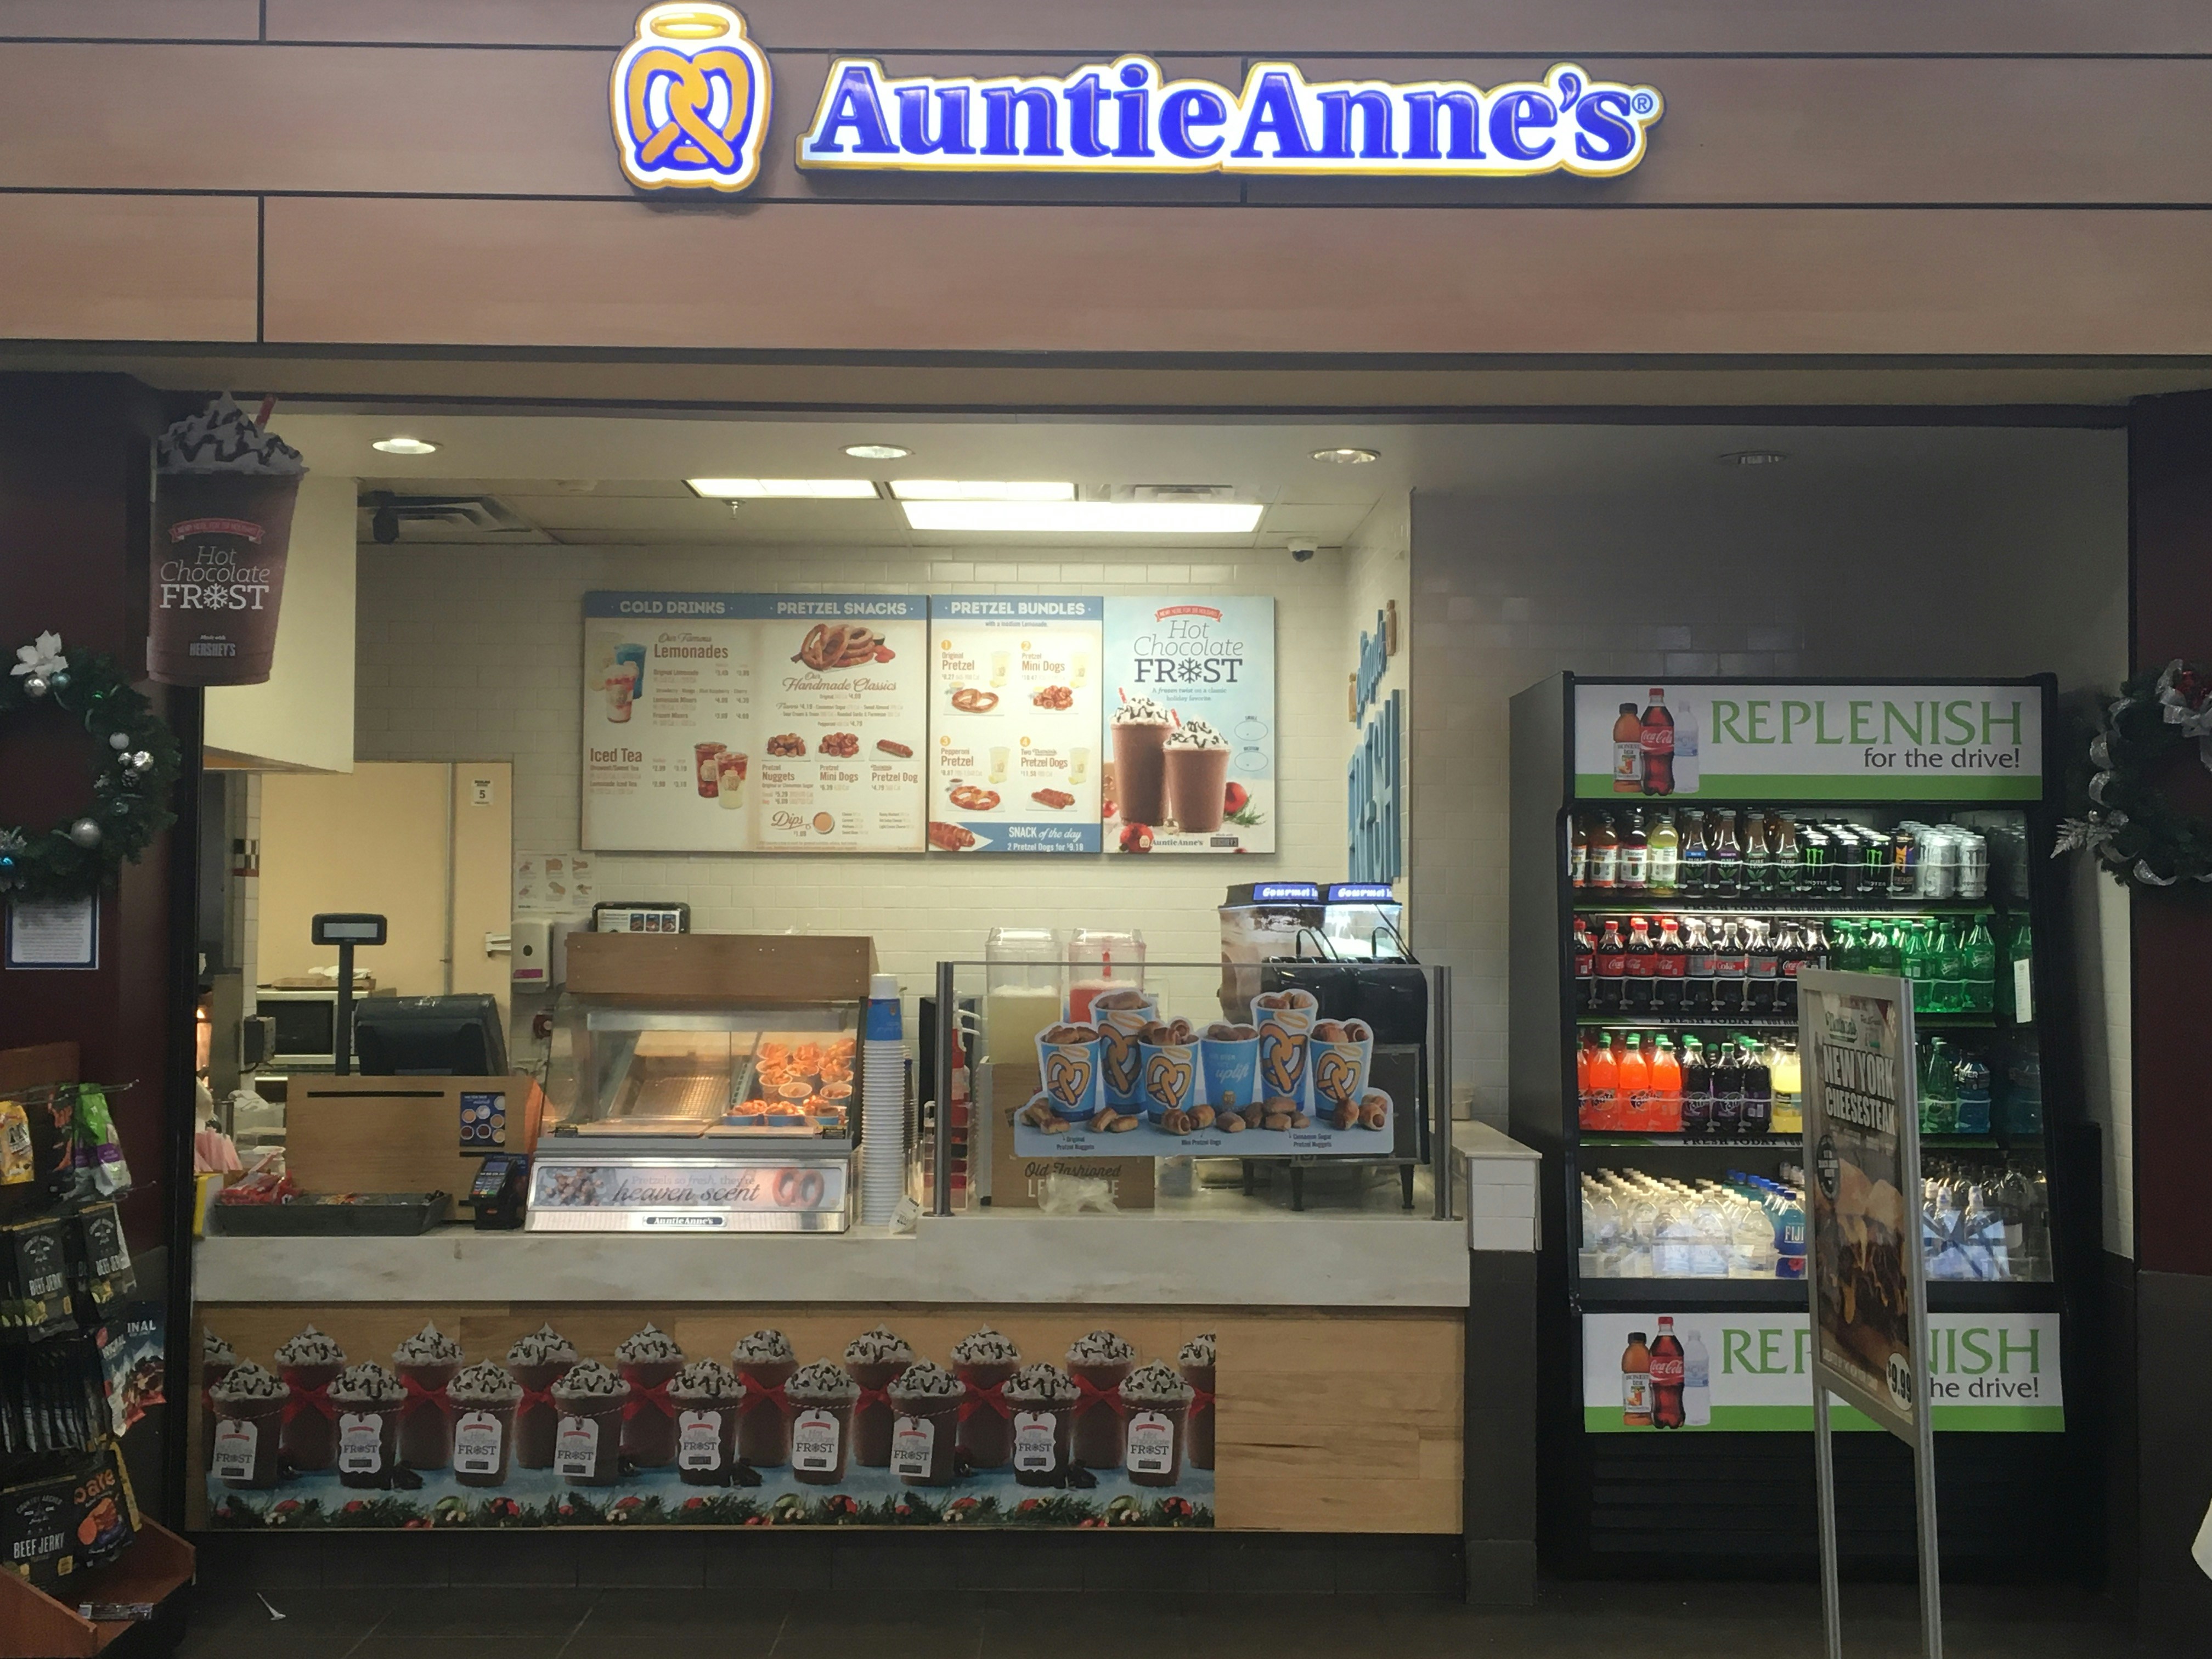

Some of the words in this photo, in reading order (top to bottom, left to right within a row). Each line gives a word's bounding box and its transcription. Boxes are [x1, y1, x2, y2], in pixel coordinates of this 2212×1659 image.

[810, 63, 1225, 160] Auntie
[1237, 71, 1636, 163] Anne's
[195, 546, 236, 565] Hot
[160, 560, 270, 583] Chocolate
[620, 601, 663, 614] COLD
[667, 601, 725, 614] DRINKS
[777, 602, 840, 614] PRETZEL
[844, 602, 907, 615] SNACKS
[951, 602, 1014, 614] PRETZEL
[1018, 602, 1085, 615] BUNDLES
[1167, 620, 1210, 639] Hot
[658, 633, 676, 642] Our
[678, 633, 712, 642] Famous
[654, 644, 728, 658] Lemonades
[1134, 634, 1243, 656] Chocolate
[942, 661, 974, 670] Pretzel
[1022, 661, 1040, 671] Mini
[1043, 661, 1065, 673] Dogs
[805, 672, 820, 680] Our
[782, 678, 851, 691] Handmade
[853, 678, 896, 692] Classics
[1711, 700, 2022, 746] REPLENISH
[590, 748, 617, 763] Iced
[621, 748, 642, 763] Tea
[941, 756, 974, 766] Pretzel
[1865, 748, 1897, 768] for
[1904, 748, 1943, 768] the
[1951, 748, 2020, 769] drive!
[1021, 758, 1047, 767] Pretzel
[1049, 758, 1068, 769] Dogs
[762, 772, 795, 782] Nuggets
[820, 772, 836, 781] Mini
[839, 772, 859, 783] Dogs
[872, 772, 900, 781] Pretzel
[902, 772, 918, 783] Dog
[479, 789, 486, 798] 5
[771, 811, 806, 830] Dips
[1009, 827, 1036, 837] SNACK
[1038, 828, 1048, 839] of
[1048, 828, 1062, 838] the
[1064, 828, 1081, 842] day
[1263, 888, 1310, 897] Gourmet
[1338, 888, 1385, 897] Gourmet
[1215, 1062, 1250, 1084] uplift
[1824, 1045, 1854, 1088] NEW
[1857, 1052, 1895, 1101] YORK
[1025, 1162, 1048, 1177] Old
[1053, 1162, 1122, 1176] Fashioned
[632, 1175, 672, 1185] Pretzels
[612, 1178, 691, 1202] heaven
[701, 1180, 760, 1201] scent
[1785, 1226, 1804, 1241] FIJI
[1968, 1377, 2039, 1397] drive!
[14, 1538, 37, 1559] BEEF
[38, 1532, 65, 1554] JERKY
